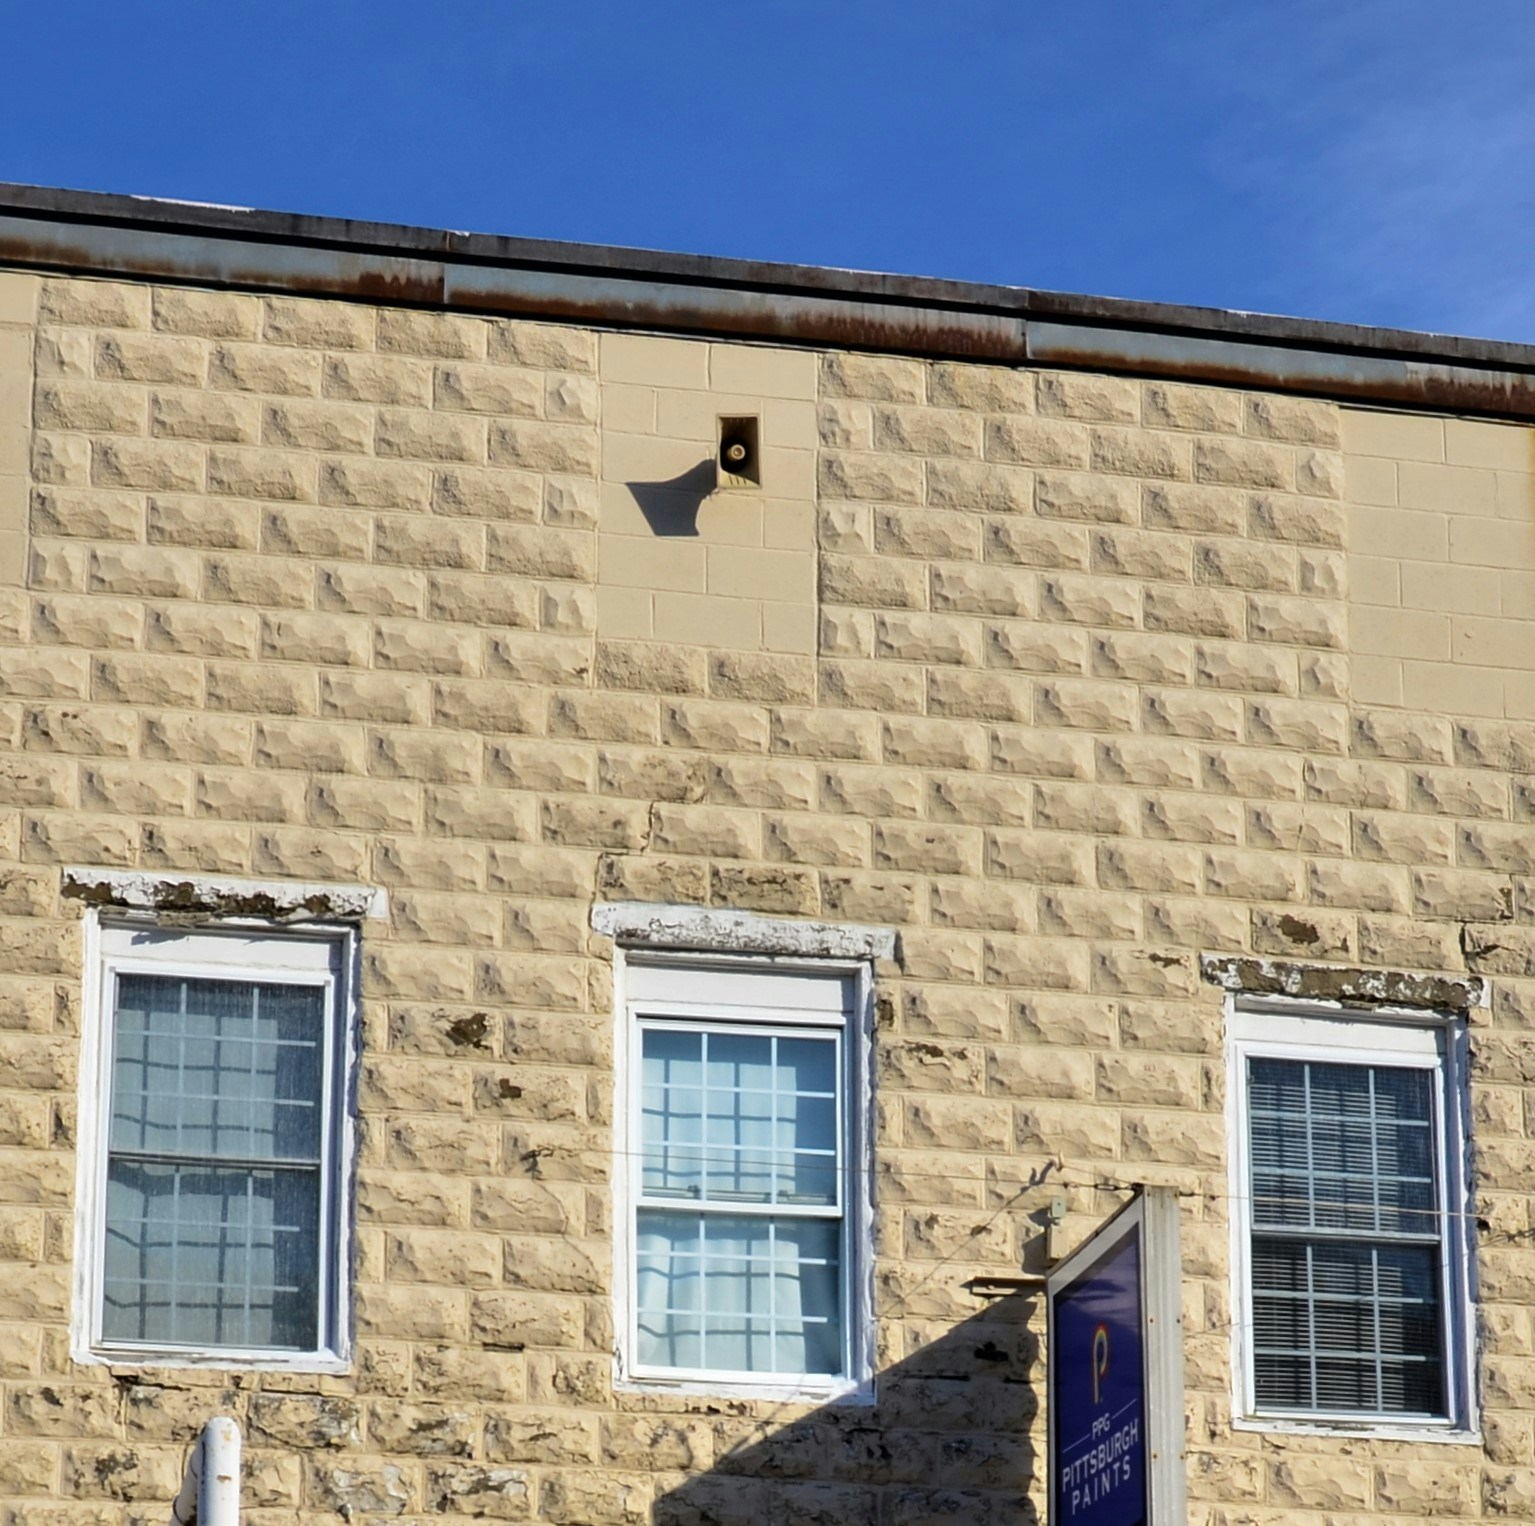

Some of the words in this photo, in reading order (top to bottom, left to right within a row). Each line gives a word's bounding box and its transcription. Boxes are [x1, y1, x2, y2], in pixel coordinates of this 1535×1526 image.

[1063, 1418, 1139, 1493] PITTSBURGH
[1092, 1413, 1111, 1440] PPG
[1072, 1455, 1131, 1515] PAINTS
